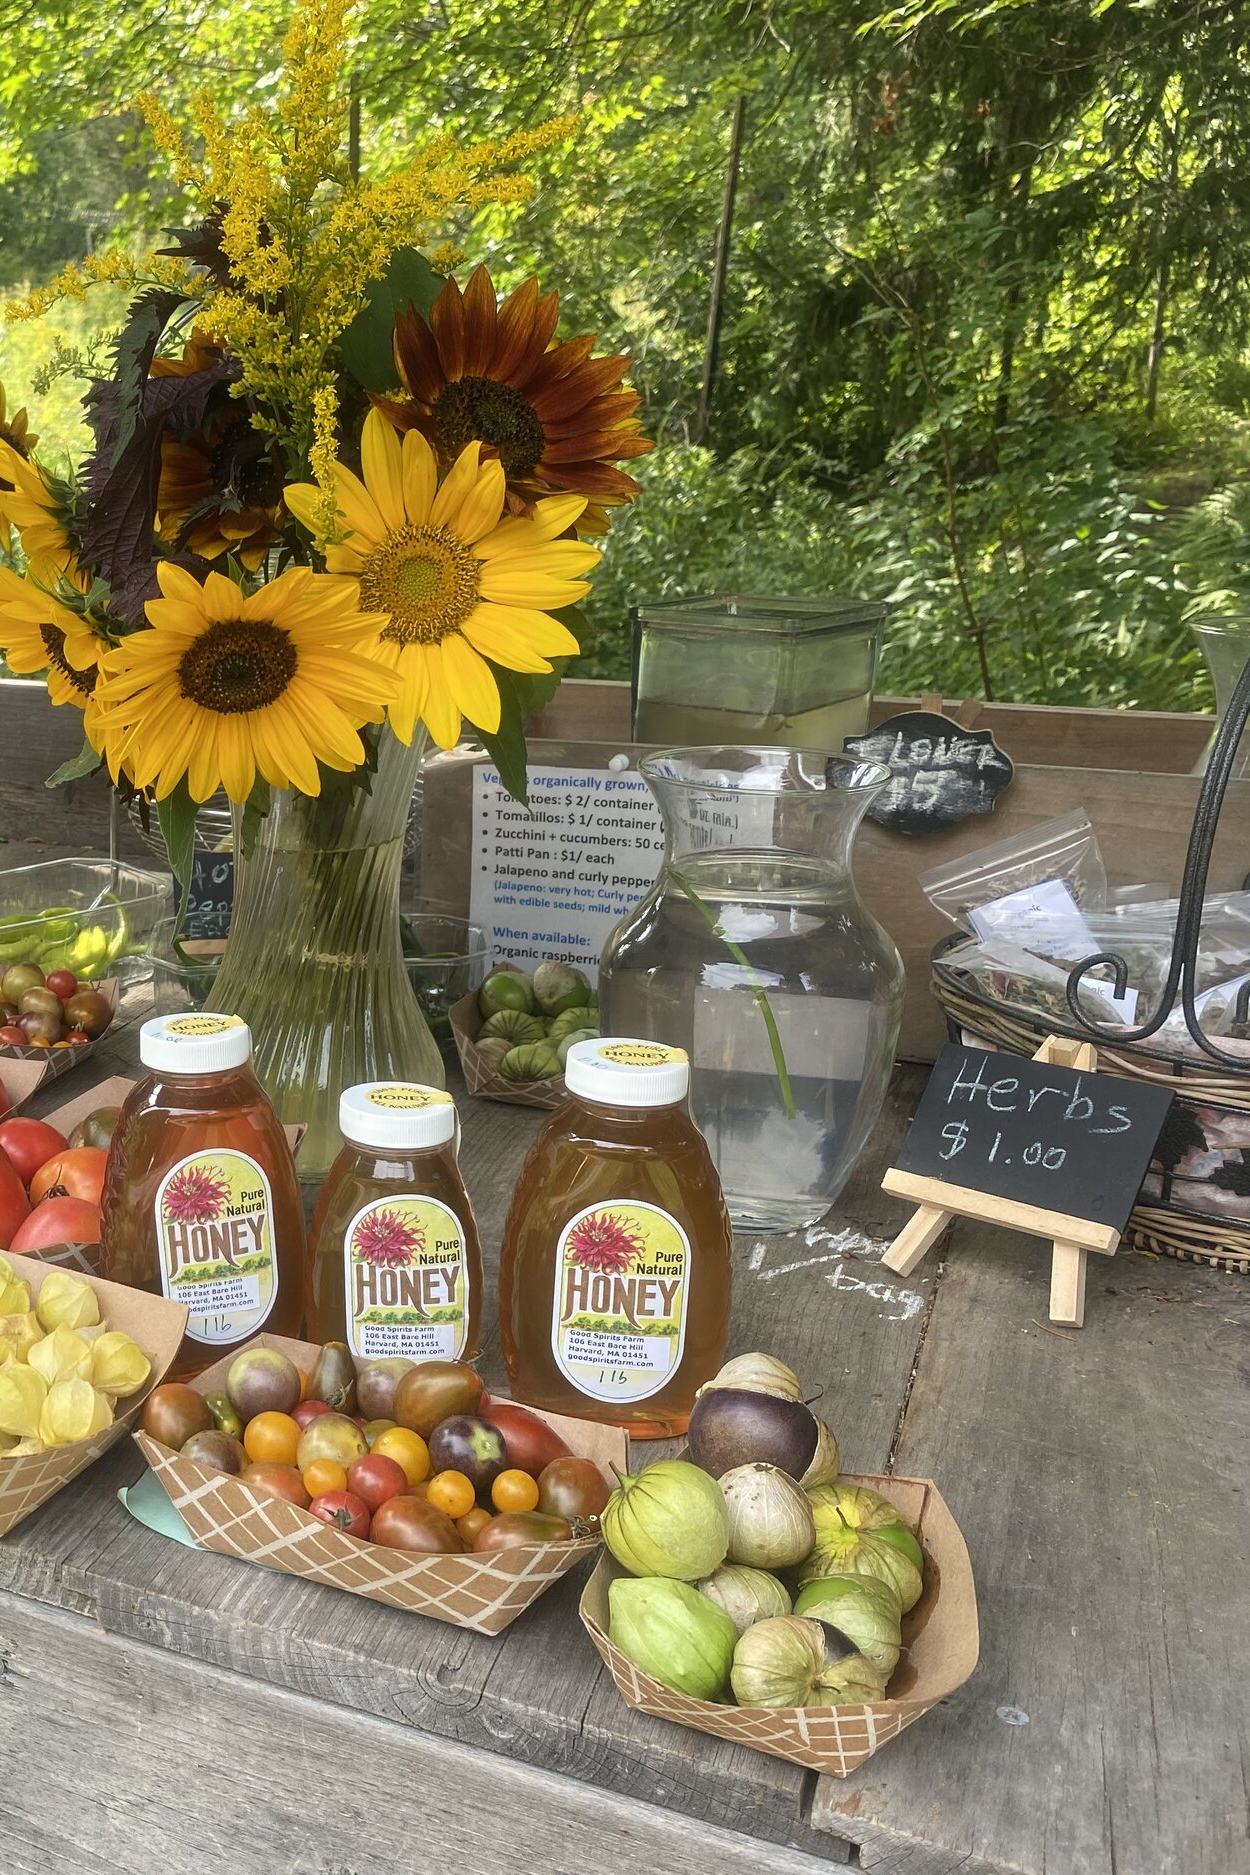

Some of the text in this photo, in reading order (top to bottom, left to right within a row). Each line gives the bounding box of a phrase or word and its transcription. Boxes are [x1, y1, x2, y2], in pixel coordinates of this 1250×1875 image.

[533, 774, 601, 791] organically
[604, 779, 649, 794] grown,
[565, 794, 572, 806] $
[593, 798, 655, 812] container
[495, 809, 565, 823] Tomatillos:
[568, 813, 575, 825] $
[596, 817, 657, 831] container
[495, 828, 546, 842] Zucchini
[559, 833, 632, 848] cucumbers:
[635, 838, 651, 849] 50
[495, 846, 615, 865] Patti Pan $1/ each
[494, 864, 549, 878] Jalapeno
[552, 869, 575, 880] and
[578, 871, 609, 885] curly
[494, 879, 624, 901] (Jalapeno: very hot; Curly
[493, 895, 517, 905] with
[519, 896, 551, 908] edible
[553, 900, 586, 912] seeds;
[588, 903, 611, 914] mild
[493, 926, 591, 946] When available:
[493, 944, 539, 959] Organic
[171, 1020, 226, 1032] HONEY
[604, 1050, 669, 1060] HONEY
[370, 1094, 430, 1102] HONEY
[947, 1055, 1132, 1135] Herbs
[938, 1119, 1068, 1170] $ 1.00
[241, 1188, 264, 1202] Pure
[226, 1201, 265, 1217] Natural
[168, 1214, 266, 1279] HONEY
[435, 1239, 460, 1252] Pure
[419, 1250, 461, 1265] Natural
[656, 1251, 683, 1263] Pure
[636, 1263, 682, 1275] Natural
[194, 1289, 210, 1297] East
[212, 1287, 229, 1295] Bare
[230, 1284, 244, 1293] Hill
[212, 1291, 248, 1302] MA 01451
[353, 1264, 461, 1318] HONEY
[560, 1267, 681, 1329] HONEY
[570, 1329, 645, 1343] Good Spirits Farm
[570, 1337, 585, 1345] 106
[587, 1340, 605, 1348] East
[608, 1342, 627, 1350] Bare
[365, 1340, 399, 1348] Harvard,
[365, 1348, 445, 1357] goodspiritsfarm.com
[568, 1345, 605, 1356] Harvard,
[622, 1351, 648, 1359] 01451
[568, 1353, 654, 1367] goodspiritsfarm.com
